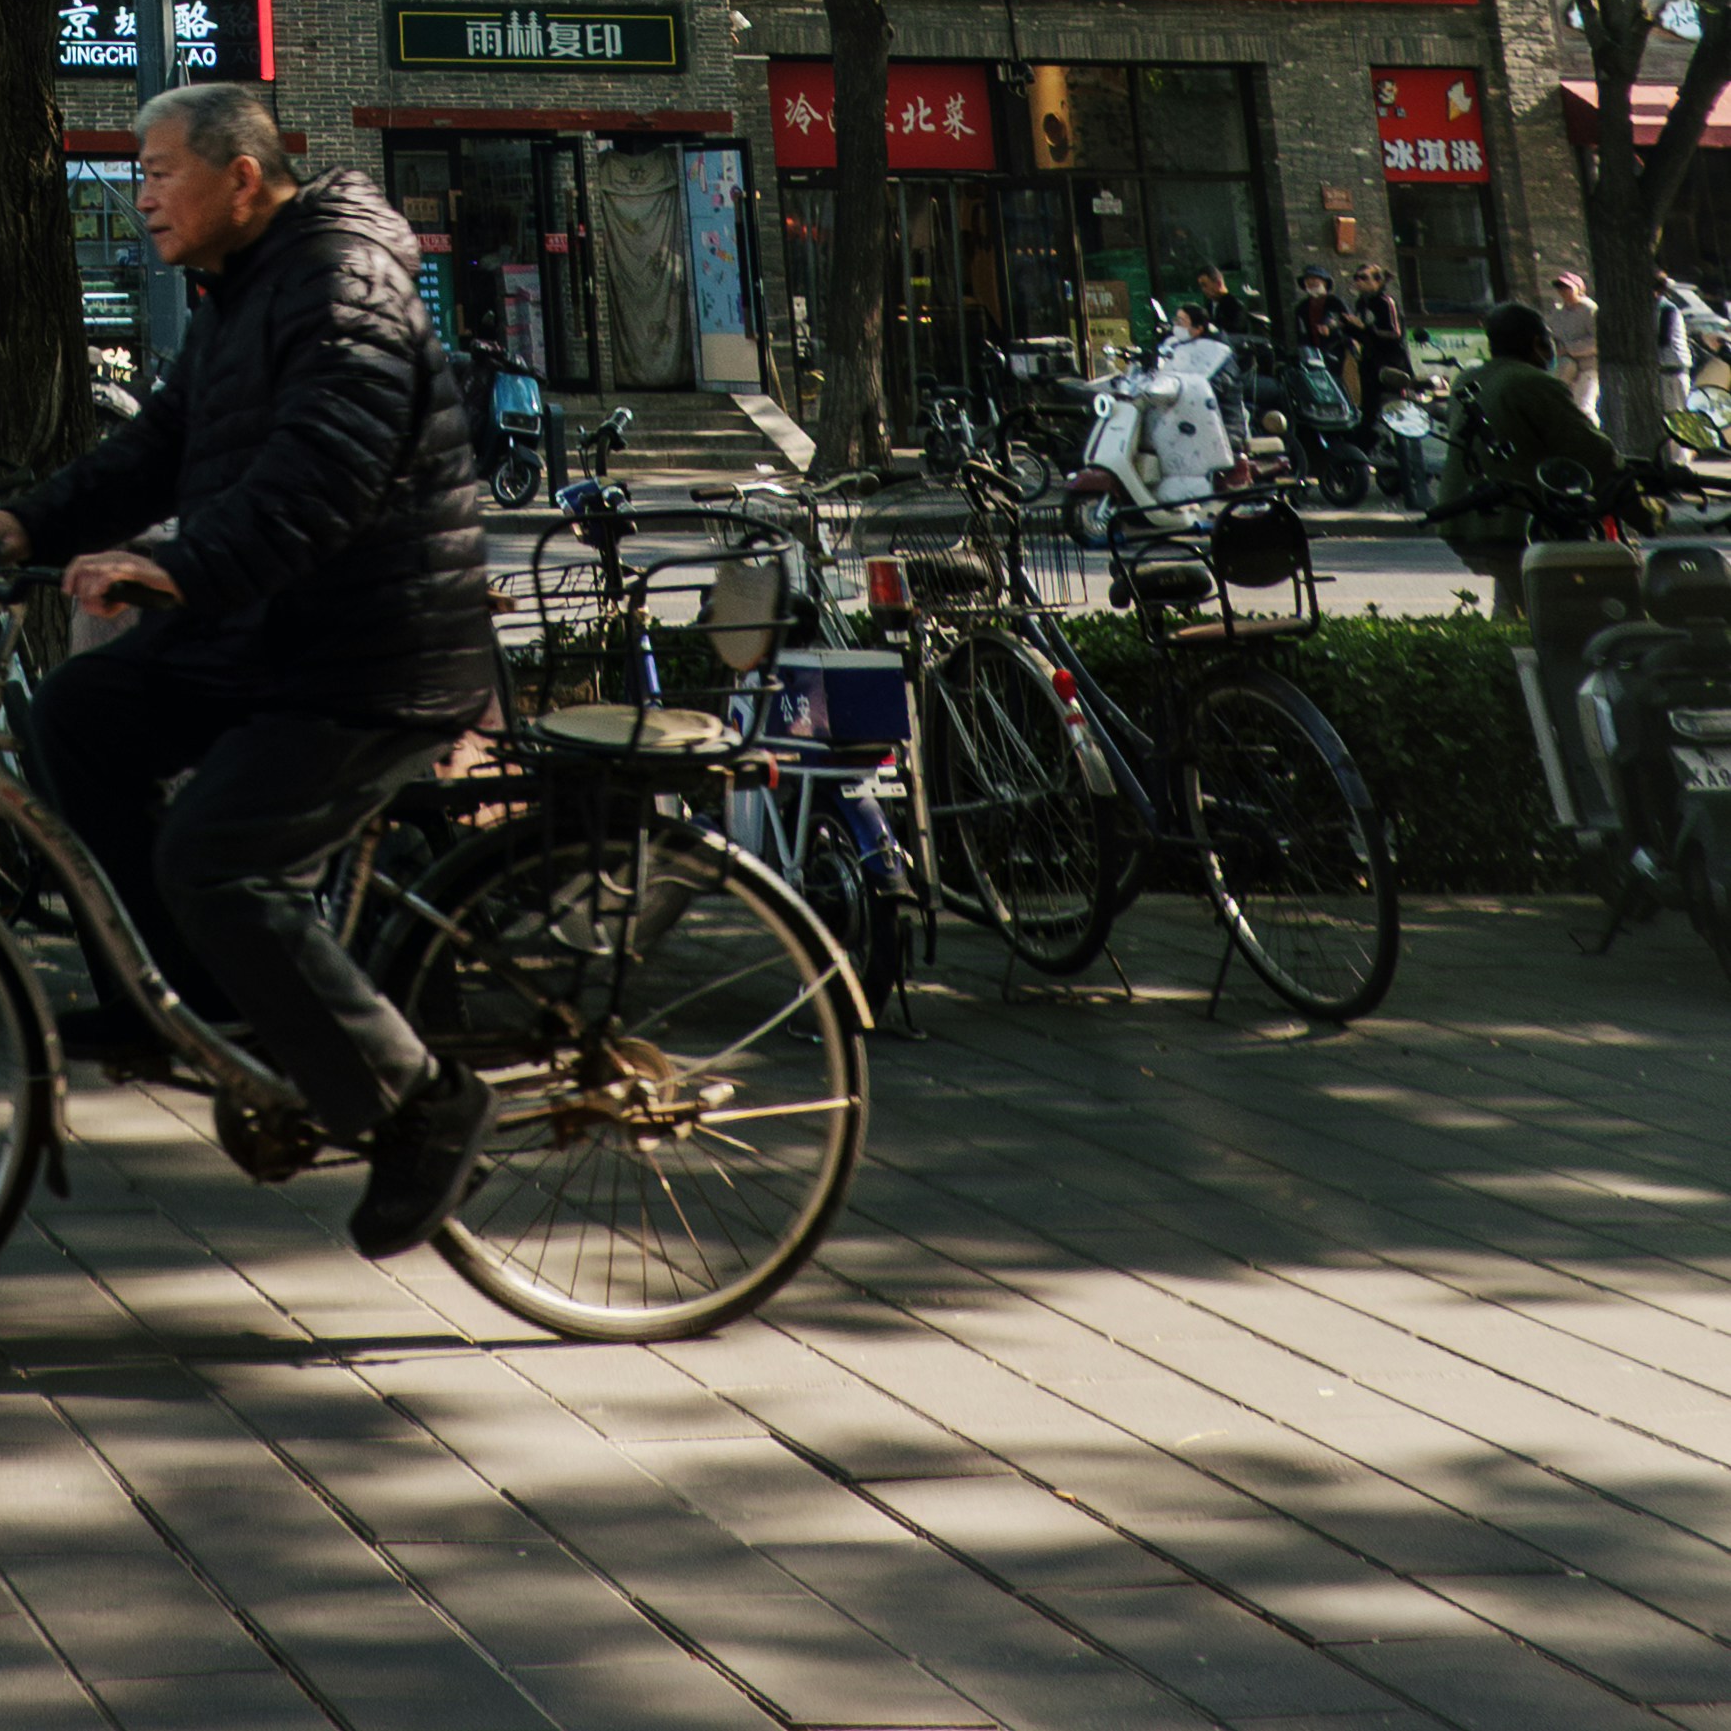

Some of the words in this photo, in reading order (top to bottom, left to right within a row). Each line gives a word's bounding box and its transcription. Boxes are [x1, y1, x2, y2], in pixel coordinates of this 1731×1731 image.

[465, 10, 623, 59] 雨林复印
[784, 91, 977, 141] 冷北菜
[1382, 138, 1483, 172] 冰淇淋
[780, 693, 812, 725] 公安
